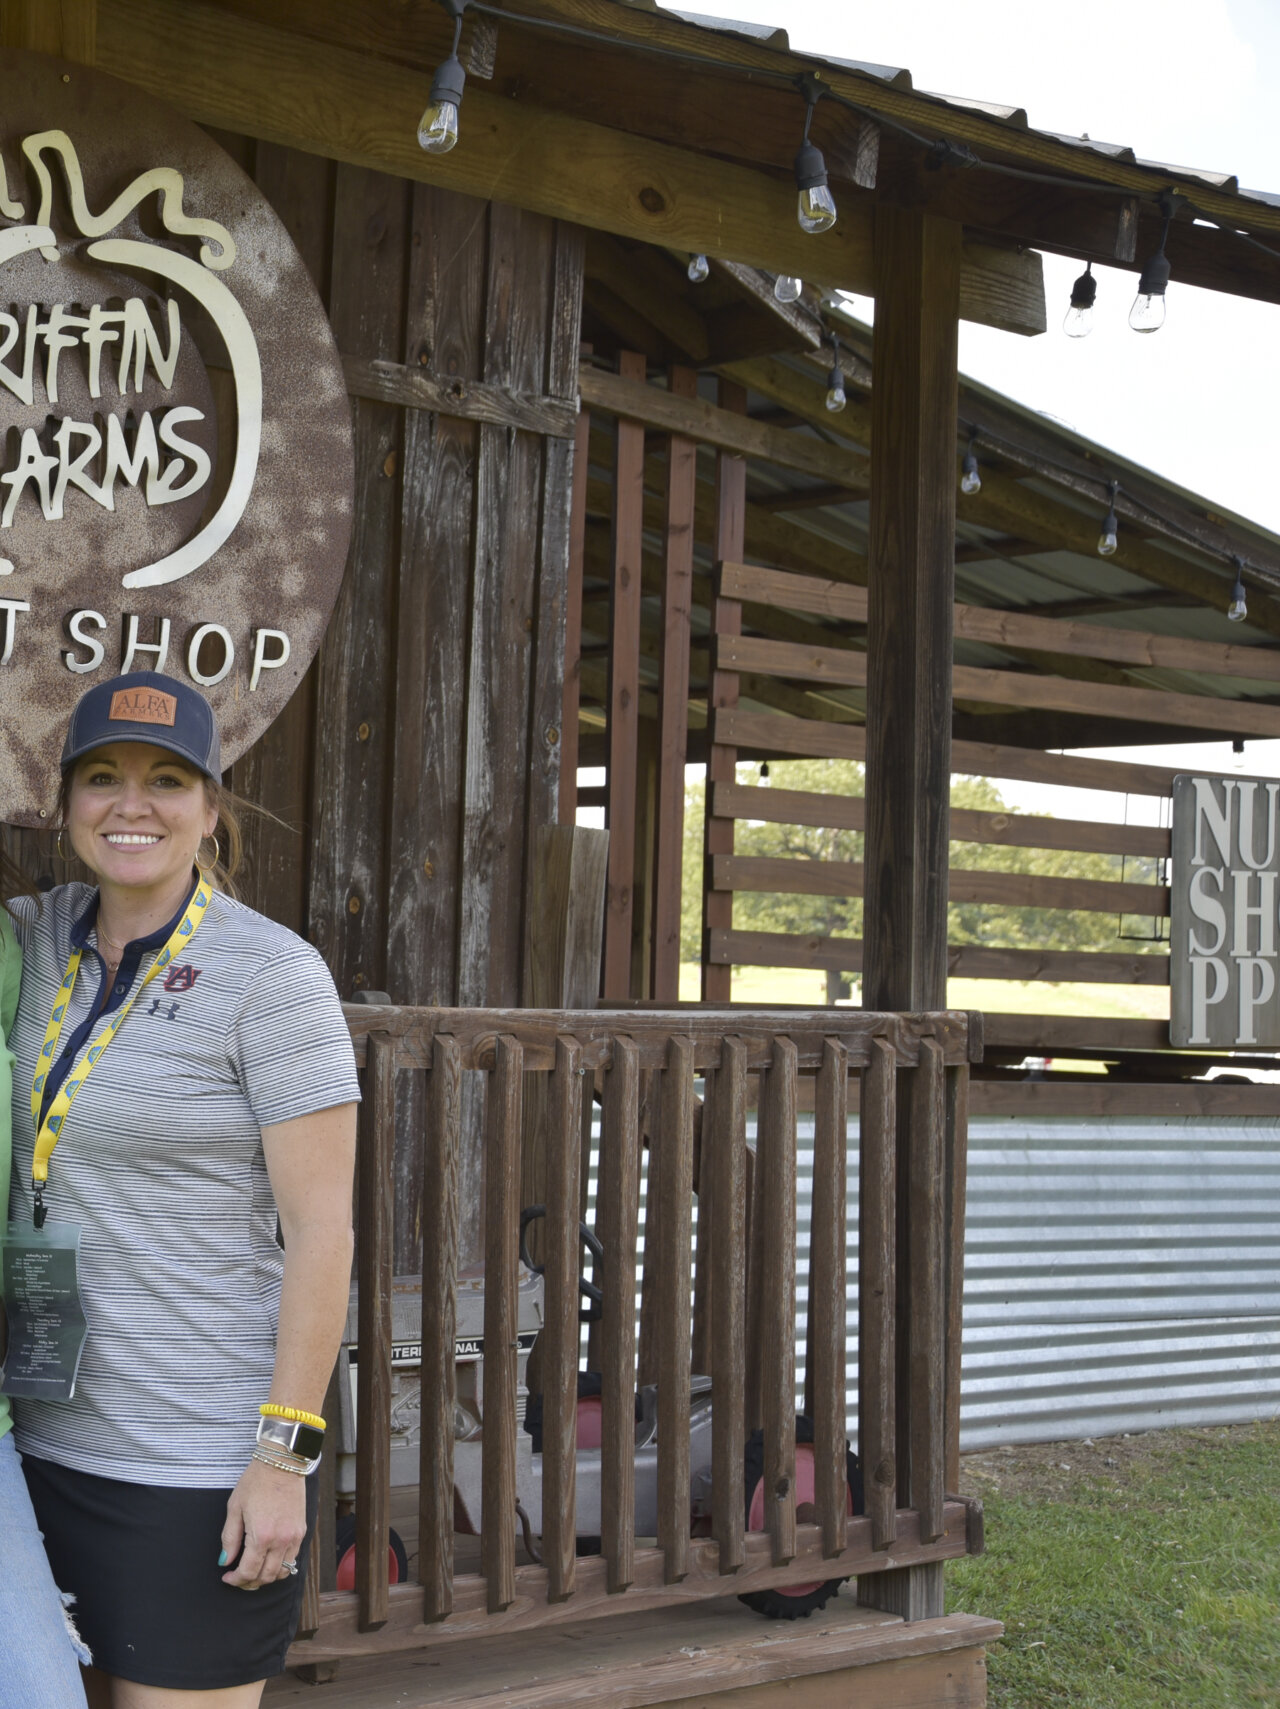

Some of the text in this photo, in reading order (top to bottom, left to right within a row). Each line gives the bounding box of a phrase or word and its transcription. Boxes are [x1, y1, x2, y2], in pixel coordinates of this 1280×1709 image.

[67, 609, 291, 691] SHOP
[120, 694, 169, 714] ALFA
[1191, 778, 1280, 870] NU
[1189, 866, 1280, 957] SH
